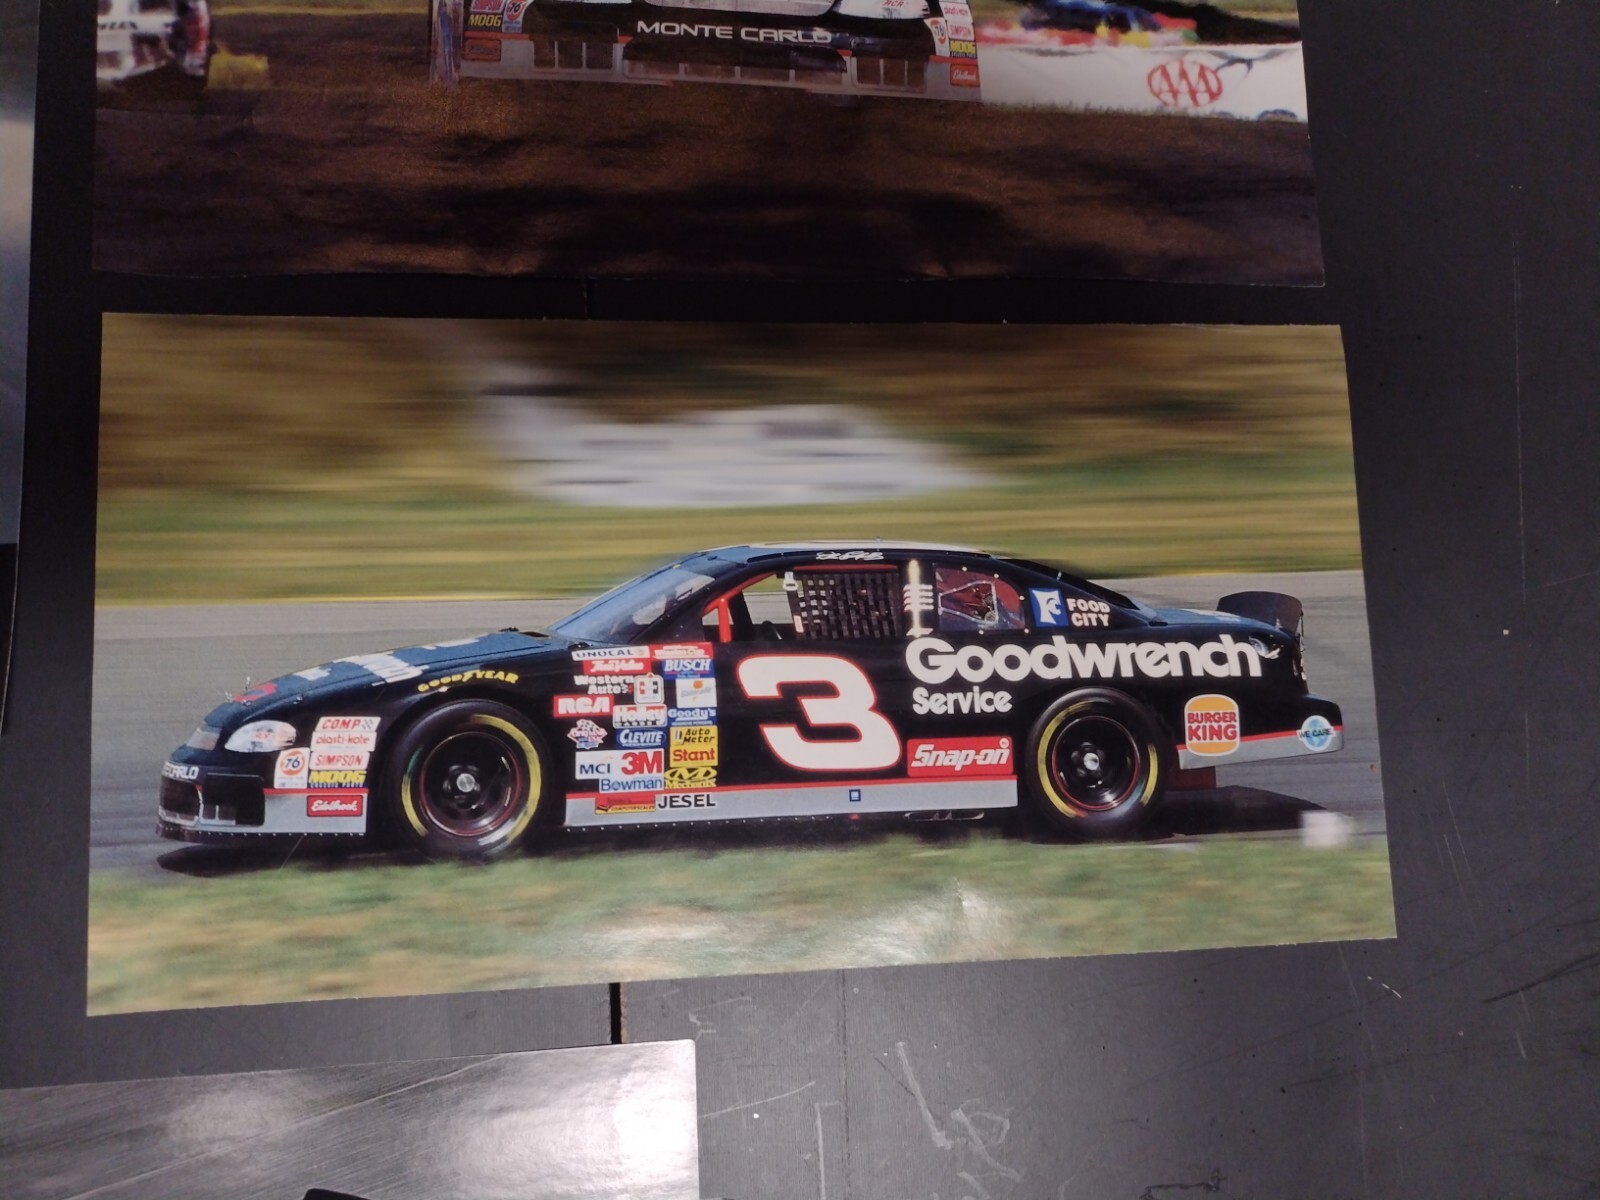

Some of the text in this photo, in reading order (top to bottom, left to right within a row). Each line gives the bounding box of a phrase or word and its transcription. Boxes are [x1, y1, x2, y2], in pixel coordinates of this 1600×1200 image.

[508, 1, 523, 13] 76
[469, 14, 502, 27] MOOG
[637, 21, 832, 43] MONTE CARLO
[1066, 597, 1111, 613] FOOD
[1071, 612, 1109, 627] CITY
[576, 649, 634, 658] UNOCAL
[905, 634, 1262, 684] Goodwrench
[664, 659, 711, 672] BUSCH
[417, 669, 519, 692] GOODYEAR
[573, 675, 634, 686] Western
[587, 685, 621, 695] Auto
[558, 697, 610, 715] RCA
[912, 686, 1013, 715] Service
[736, 654, 902, 772] 3
[1187, 712, 1237, 724] BURGER
[322, 719, 361, 730] COMP
[620, 729, 664, 744] CLEVITE
[685, 728, 710, 736] Auto
[1187, 725, 1237, 741] KING
[683, 736, 715, 744] Meter
[315, 755, 363, 766] SIMPSON
[672, 748, 715, 763] Stant
[911, 744, 1010, 771] Snap-on
[284, 757, 301, 769] 76
[580, 763, 611, 775] MCI
[621, 751, 663, 775] 3M
[309, 771, 367, 783] MOOG
[600, 778, 663, 792] Bowman
[658, 794, 716, 809] JESEL
